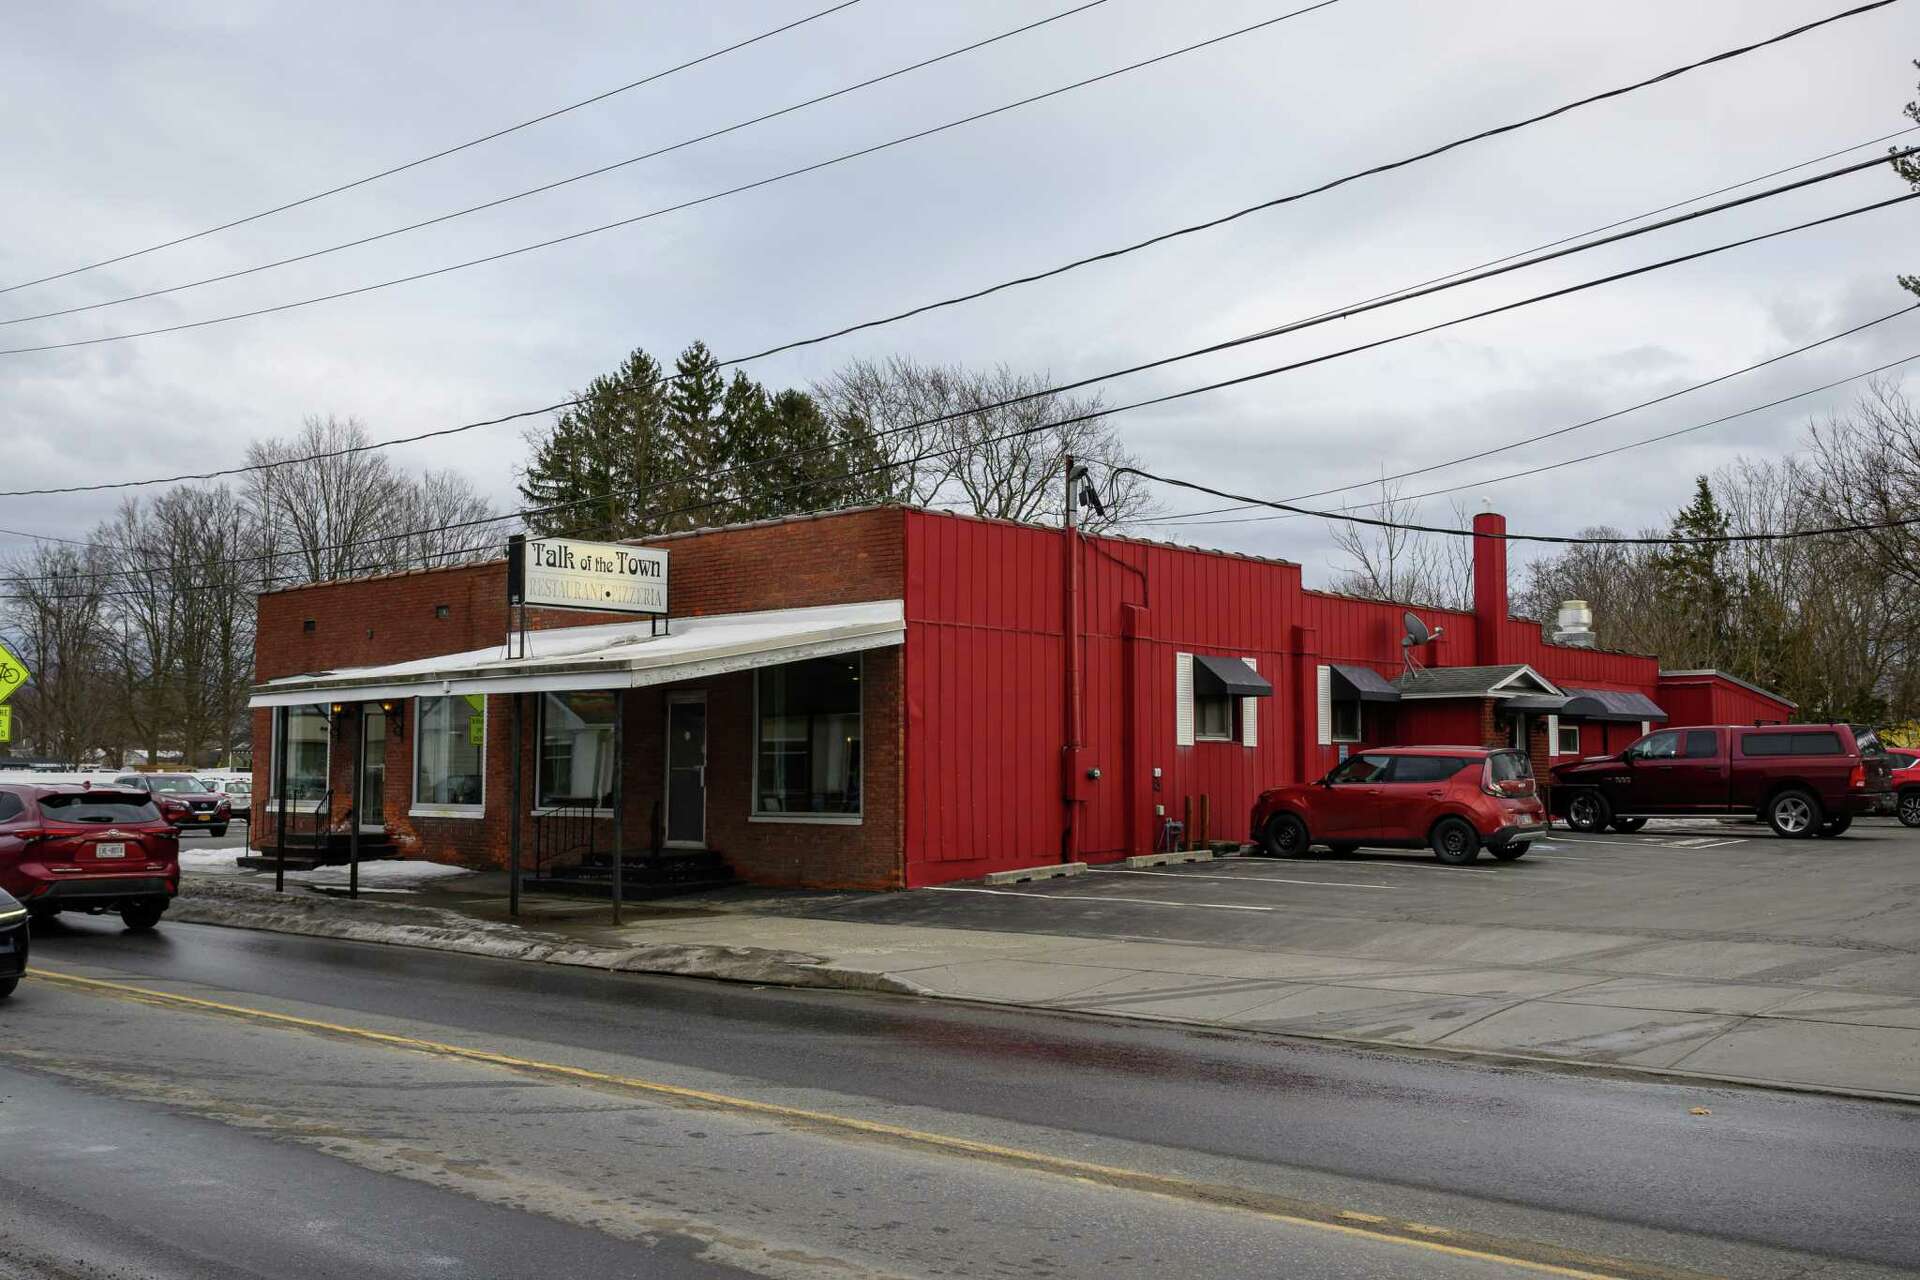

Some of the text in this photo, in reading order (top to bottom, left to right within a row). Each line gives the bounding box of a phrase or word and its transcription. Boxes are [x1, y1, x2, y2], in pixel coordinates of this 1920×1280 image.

[532, 542, 661, 578] Talk of the Town
